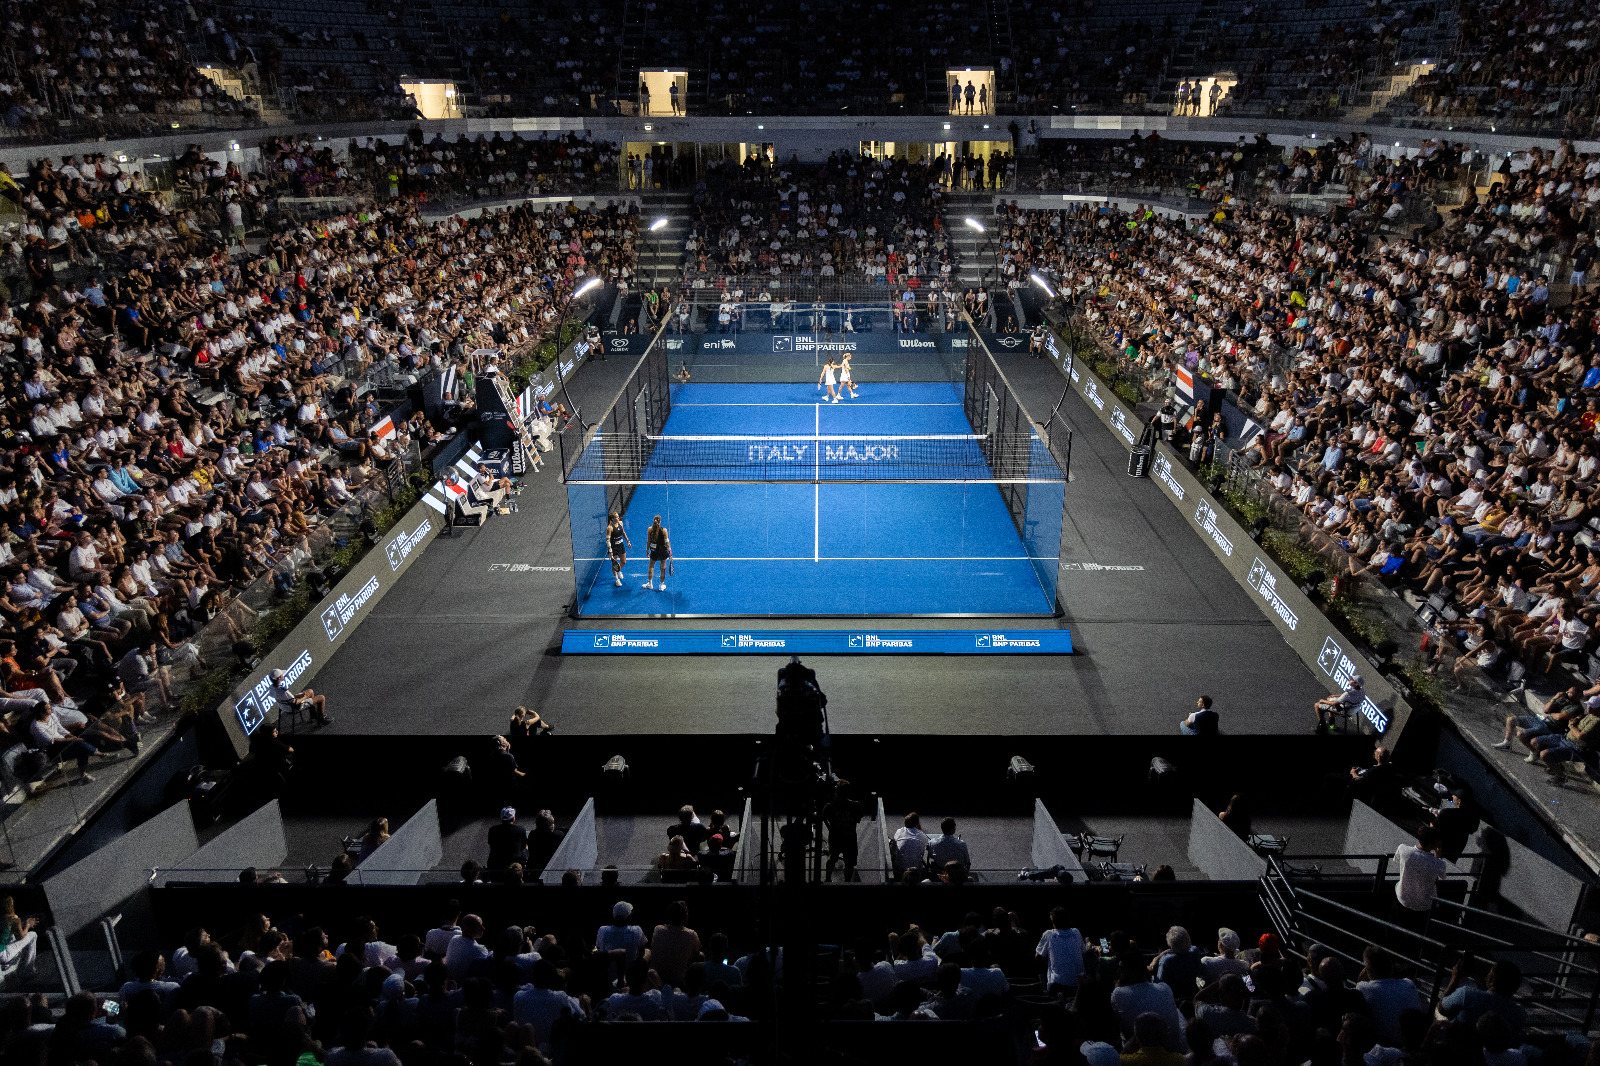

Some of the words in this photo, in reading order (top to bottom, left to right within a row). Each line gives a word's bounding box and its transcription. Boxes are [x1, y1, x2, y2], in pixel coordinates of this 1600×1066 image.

[703, 340, 721, 349] eni
[899, 339, 936, 348] Wilson
[511, 440, 523, 474] Wilson
[749, 445, 808, 460] ITALY
[826, 445, 899, 460] MAJOR
[1135, 455, 1144, 476] Wilson
[1264, 571, 1276, 590] BNL
[336, 593, 350, 611] BNL
[341, 604, 355, 624] BNP
[354, 578, 379, 610] PARIBAS
[1259, 584, 1273, 601] BNP
[1271, 597, 1297, 630] PARIBAS
[262, 695, 277, 712] BN
[1360, 700, 1386, 733] RIBAS
